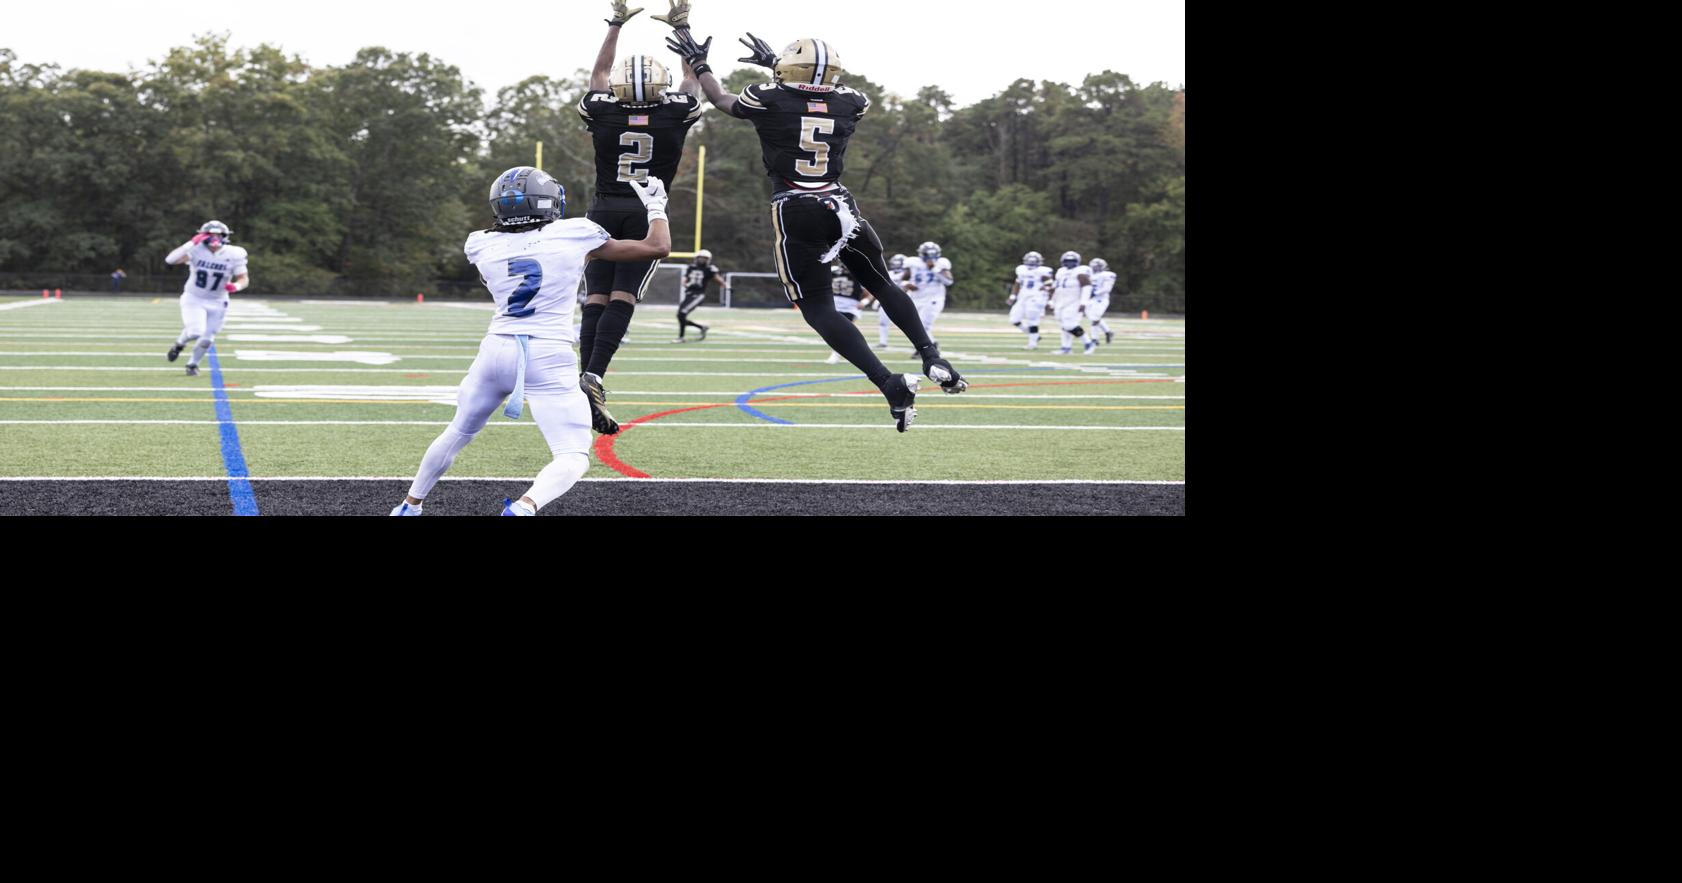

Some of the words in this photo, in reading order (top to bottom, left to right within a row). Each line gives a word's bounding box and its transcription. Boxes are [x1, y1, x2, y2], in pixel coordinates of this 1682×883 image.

[799, 84, 831, 92] Riddell
[616, 131, 654, 183] 2
[795, 116, 835, 177] 5
[502, 258, 543, 318] 2
